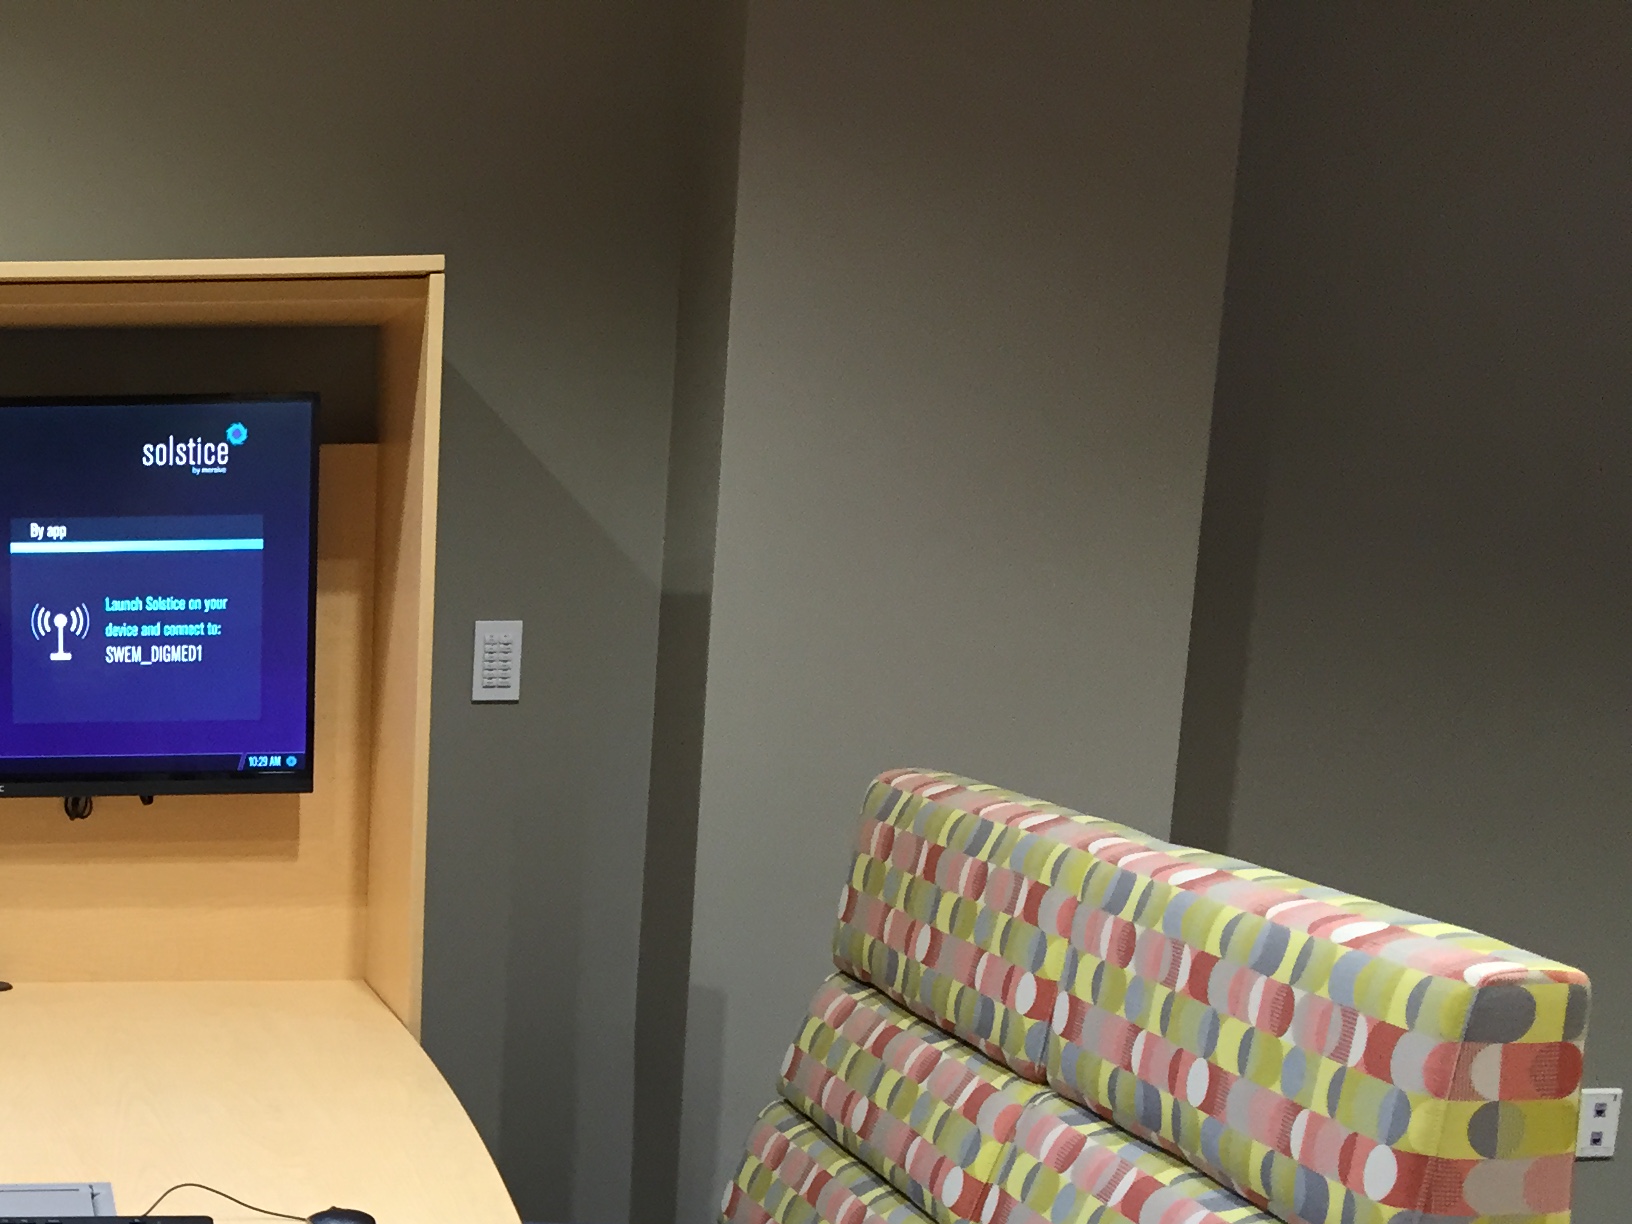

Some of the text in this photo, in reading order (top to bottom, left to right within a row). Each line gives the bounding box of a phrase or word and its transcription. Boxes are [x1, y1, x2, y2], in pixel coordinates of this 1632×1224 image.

[142, 434, 229, 467] solstice
[29, 522, 67, 541] By app
[105, 595, 229, 613] Launch Solstice on your
[105, 621, 222, 637] device and connect to:
[105, 644, 203, 666] SWEM_DIGMED1
[269, 755, 282, 767] AM
